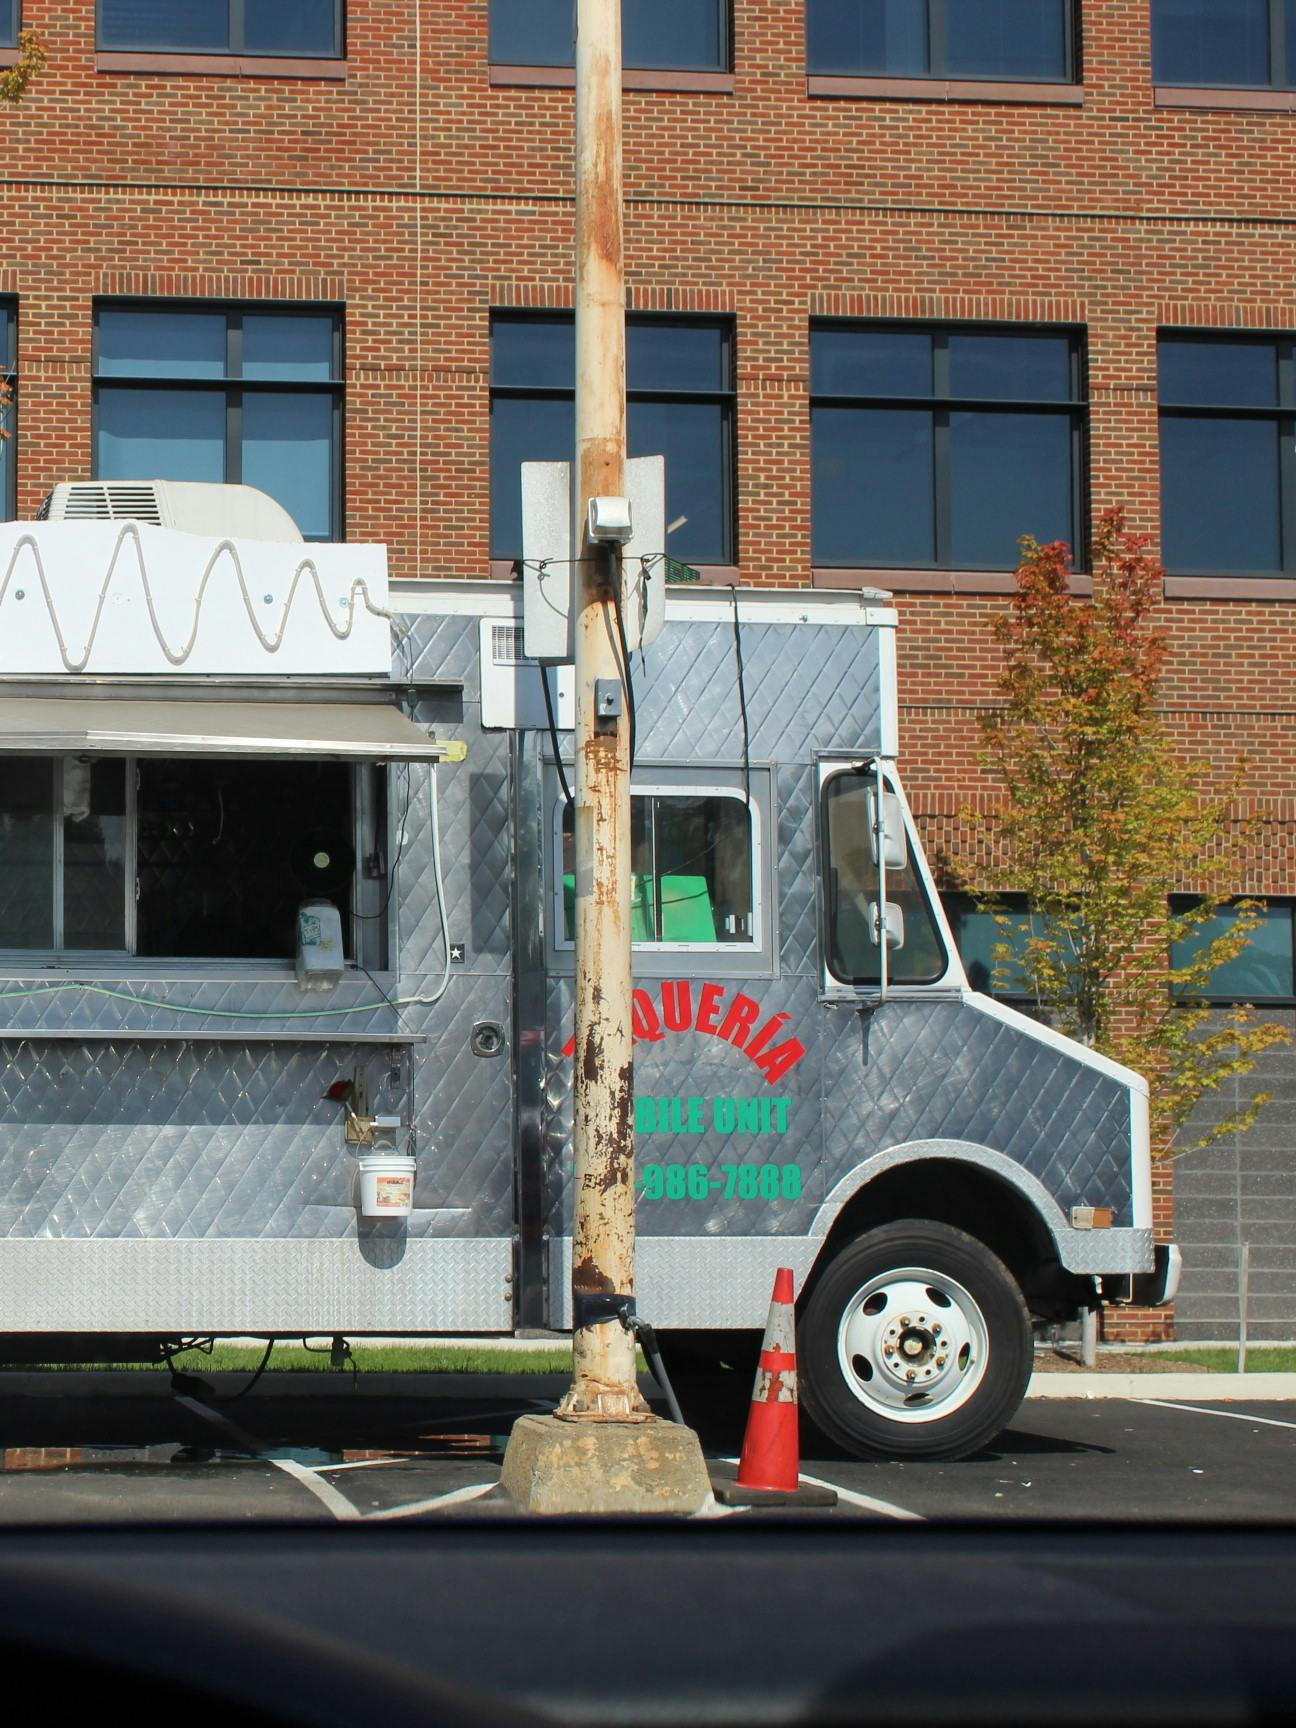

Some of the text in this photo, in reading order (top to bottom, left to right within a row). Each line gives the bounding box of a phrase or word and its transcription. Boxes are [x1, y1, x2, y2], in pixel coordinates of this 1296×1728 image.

[561, 980, 806, 1086] QUERÍA
[634, 1096, 792, 1134] BILE UNIT
[634, 1163, 803, 1201] -986-7888
